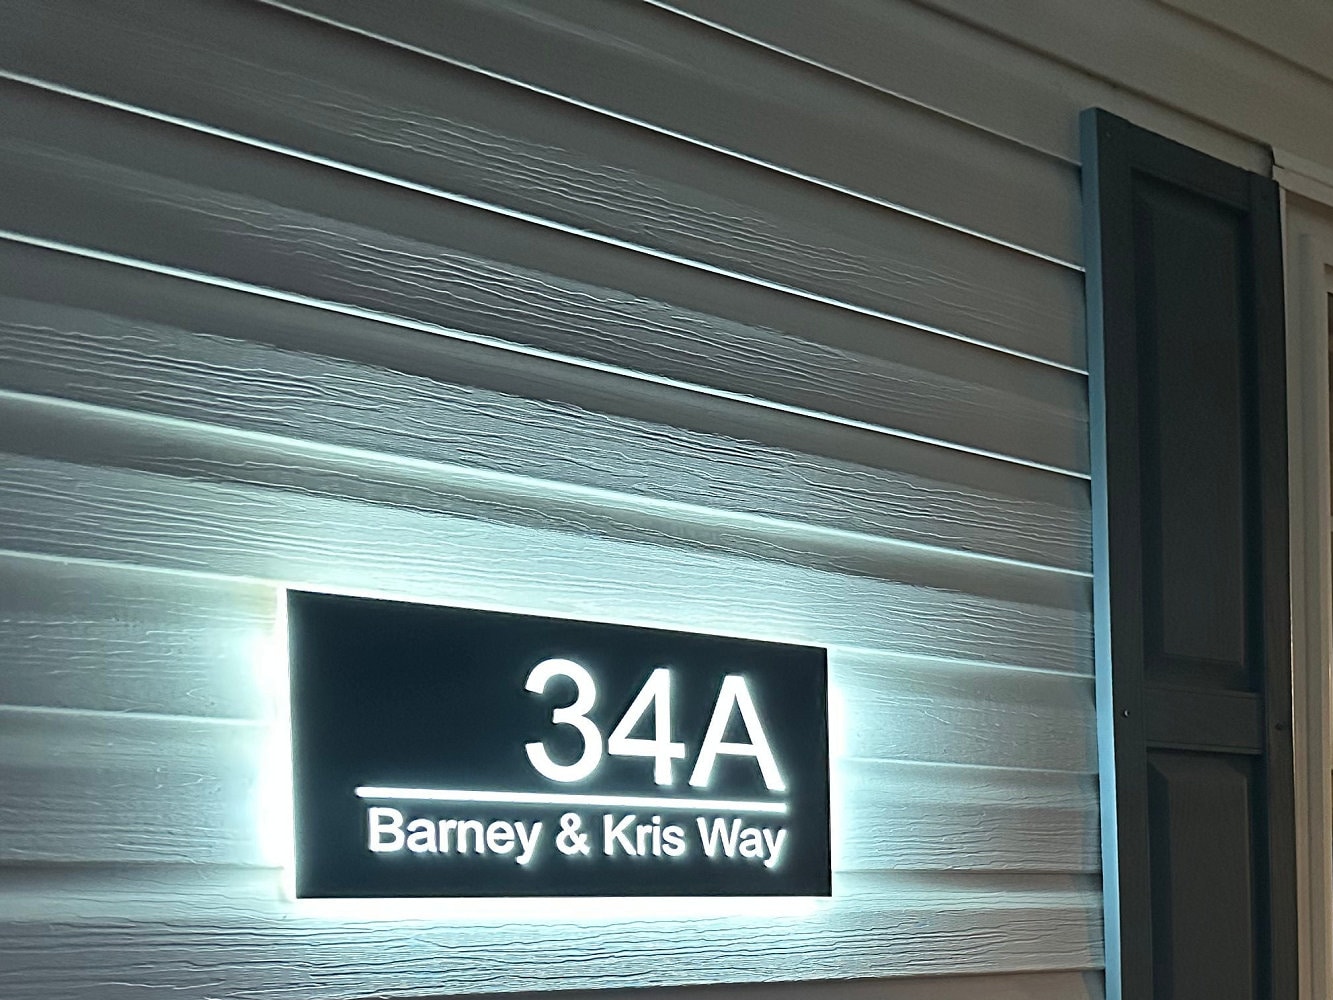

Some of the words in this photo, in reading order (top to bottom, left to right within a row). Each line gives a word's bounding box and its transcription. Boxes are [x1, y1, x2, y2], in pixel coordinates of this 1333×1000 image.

[526, 659, 786, 791] 34A
[369, 807, 542, 865] Barney
[556, 813, 590, 855] &
[604, 815, 686, 857] Kris
[697, 817, 786, 868] Way
